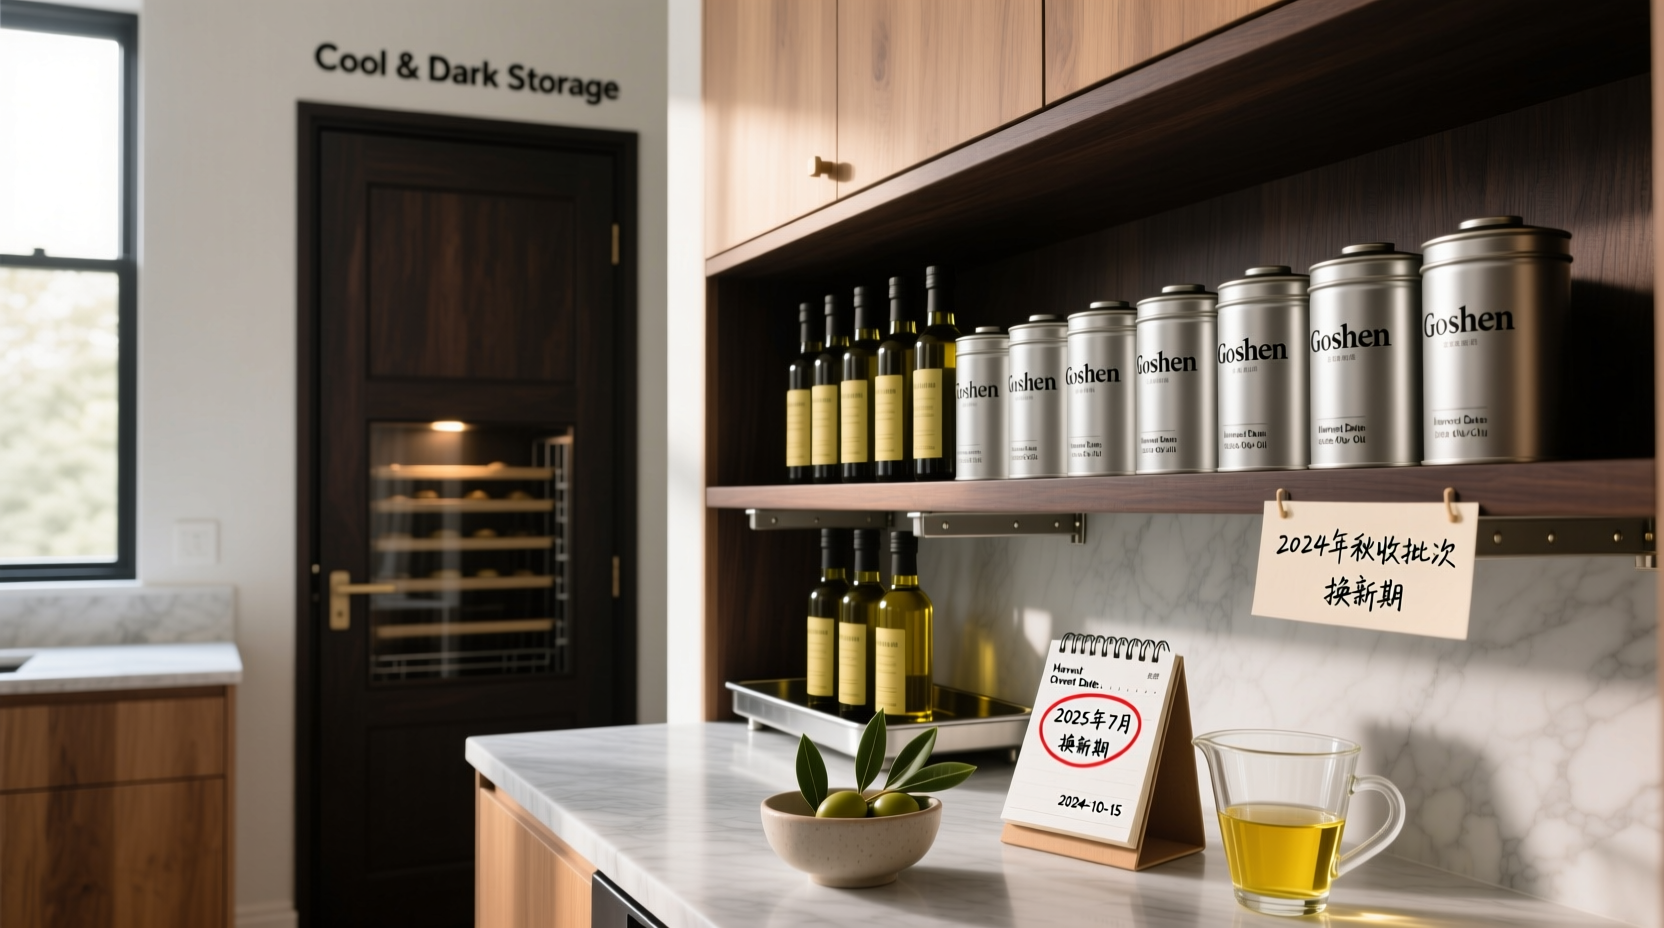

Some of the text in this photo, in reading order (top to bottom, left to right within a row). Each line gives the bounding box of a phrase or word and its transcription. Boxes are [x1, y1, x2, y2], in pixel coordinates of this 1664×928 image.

[314, 42, 620, 106] Cool & Dark Storage
[1423, 305, 1514, 339] Goshen
[1217, 338, 1288, 365] Goshen
[1310, 323, 1391, 353] Goshen
[1065, 363, 1121, 386] Goshen
[1136, 350, 1197, 375] Goshen
[1276, 528, 1456, 568] 2024年秋收批次
[1323, 575, 1404, 612] 换新期
[1054, 708, 1131, 735] 2025年7月
[1058, 733, 1110, 759] 换新期
[1057, 794, 1123, 817] 2024-10-15
